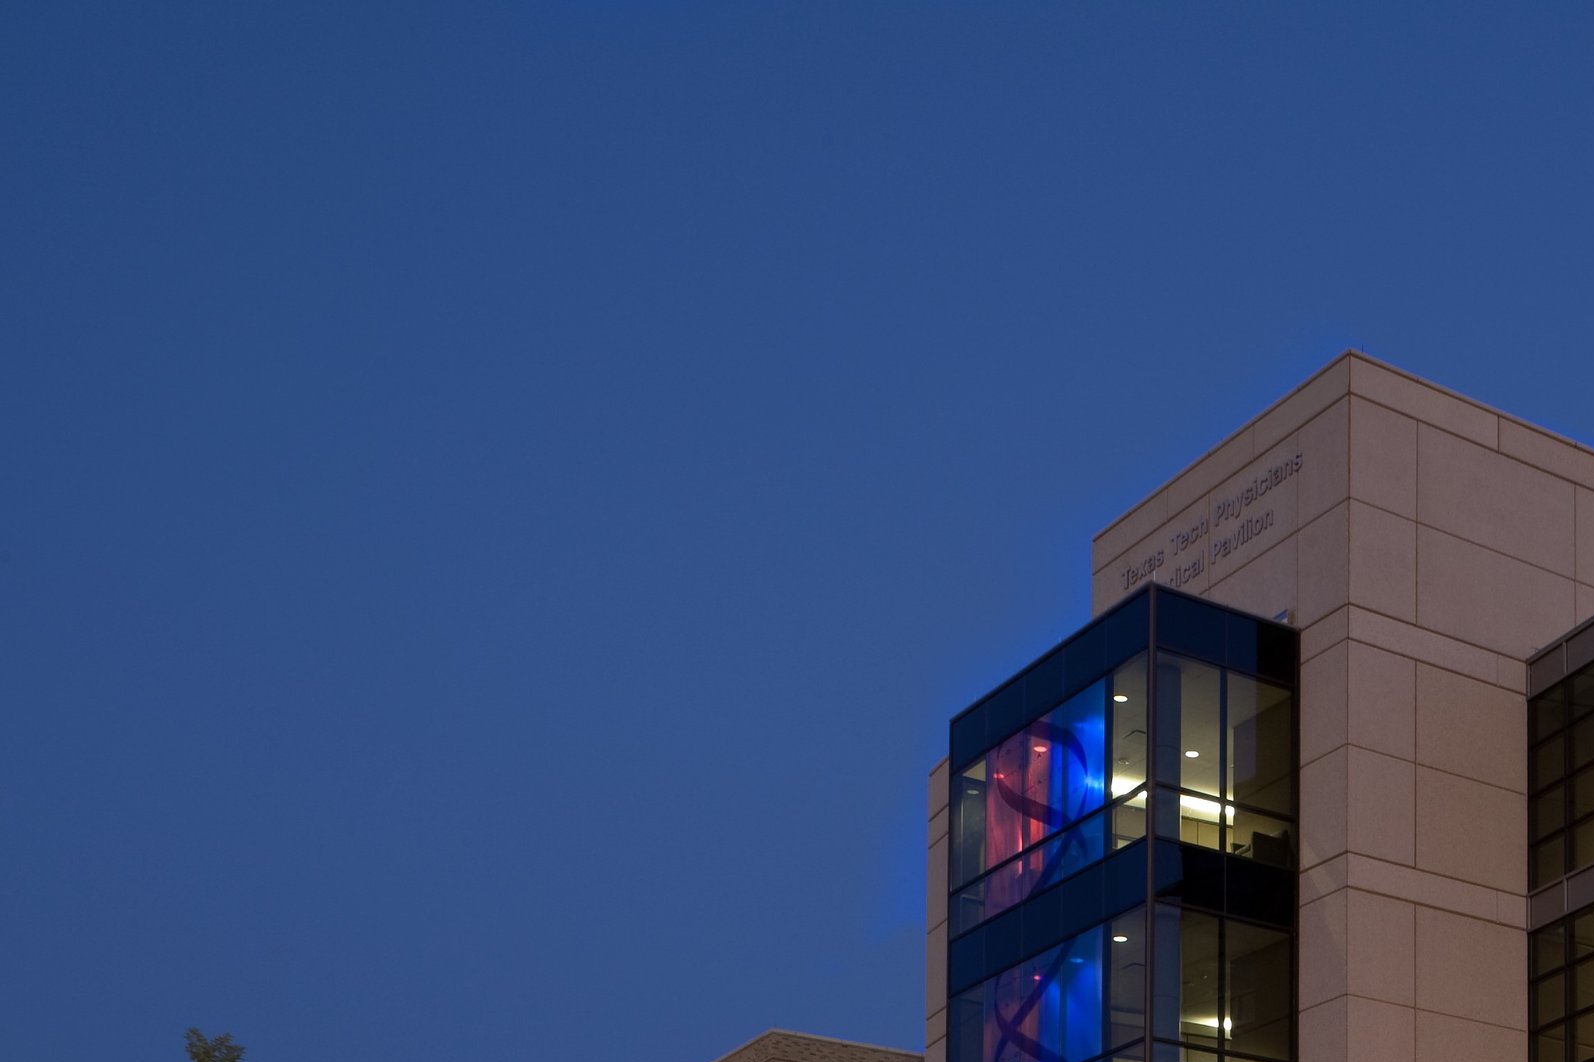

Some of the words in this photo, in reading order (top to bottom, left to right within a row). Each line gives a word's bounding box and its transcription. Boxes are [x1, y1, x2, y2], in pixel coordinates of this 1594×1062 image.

[1121, 550, 1165, 590] Texas
[1171, 519, 1209, 556] Tech
[1214, 452, 1304, 527] Physicians
[1211, 509, 1274, 565] Pavilion
